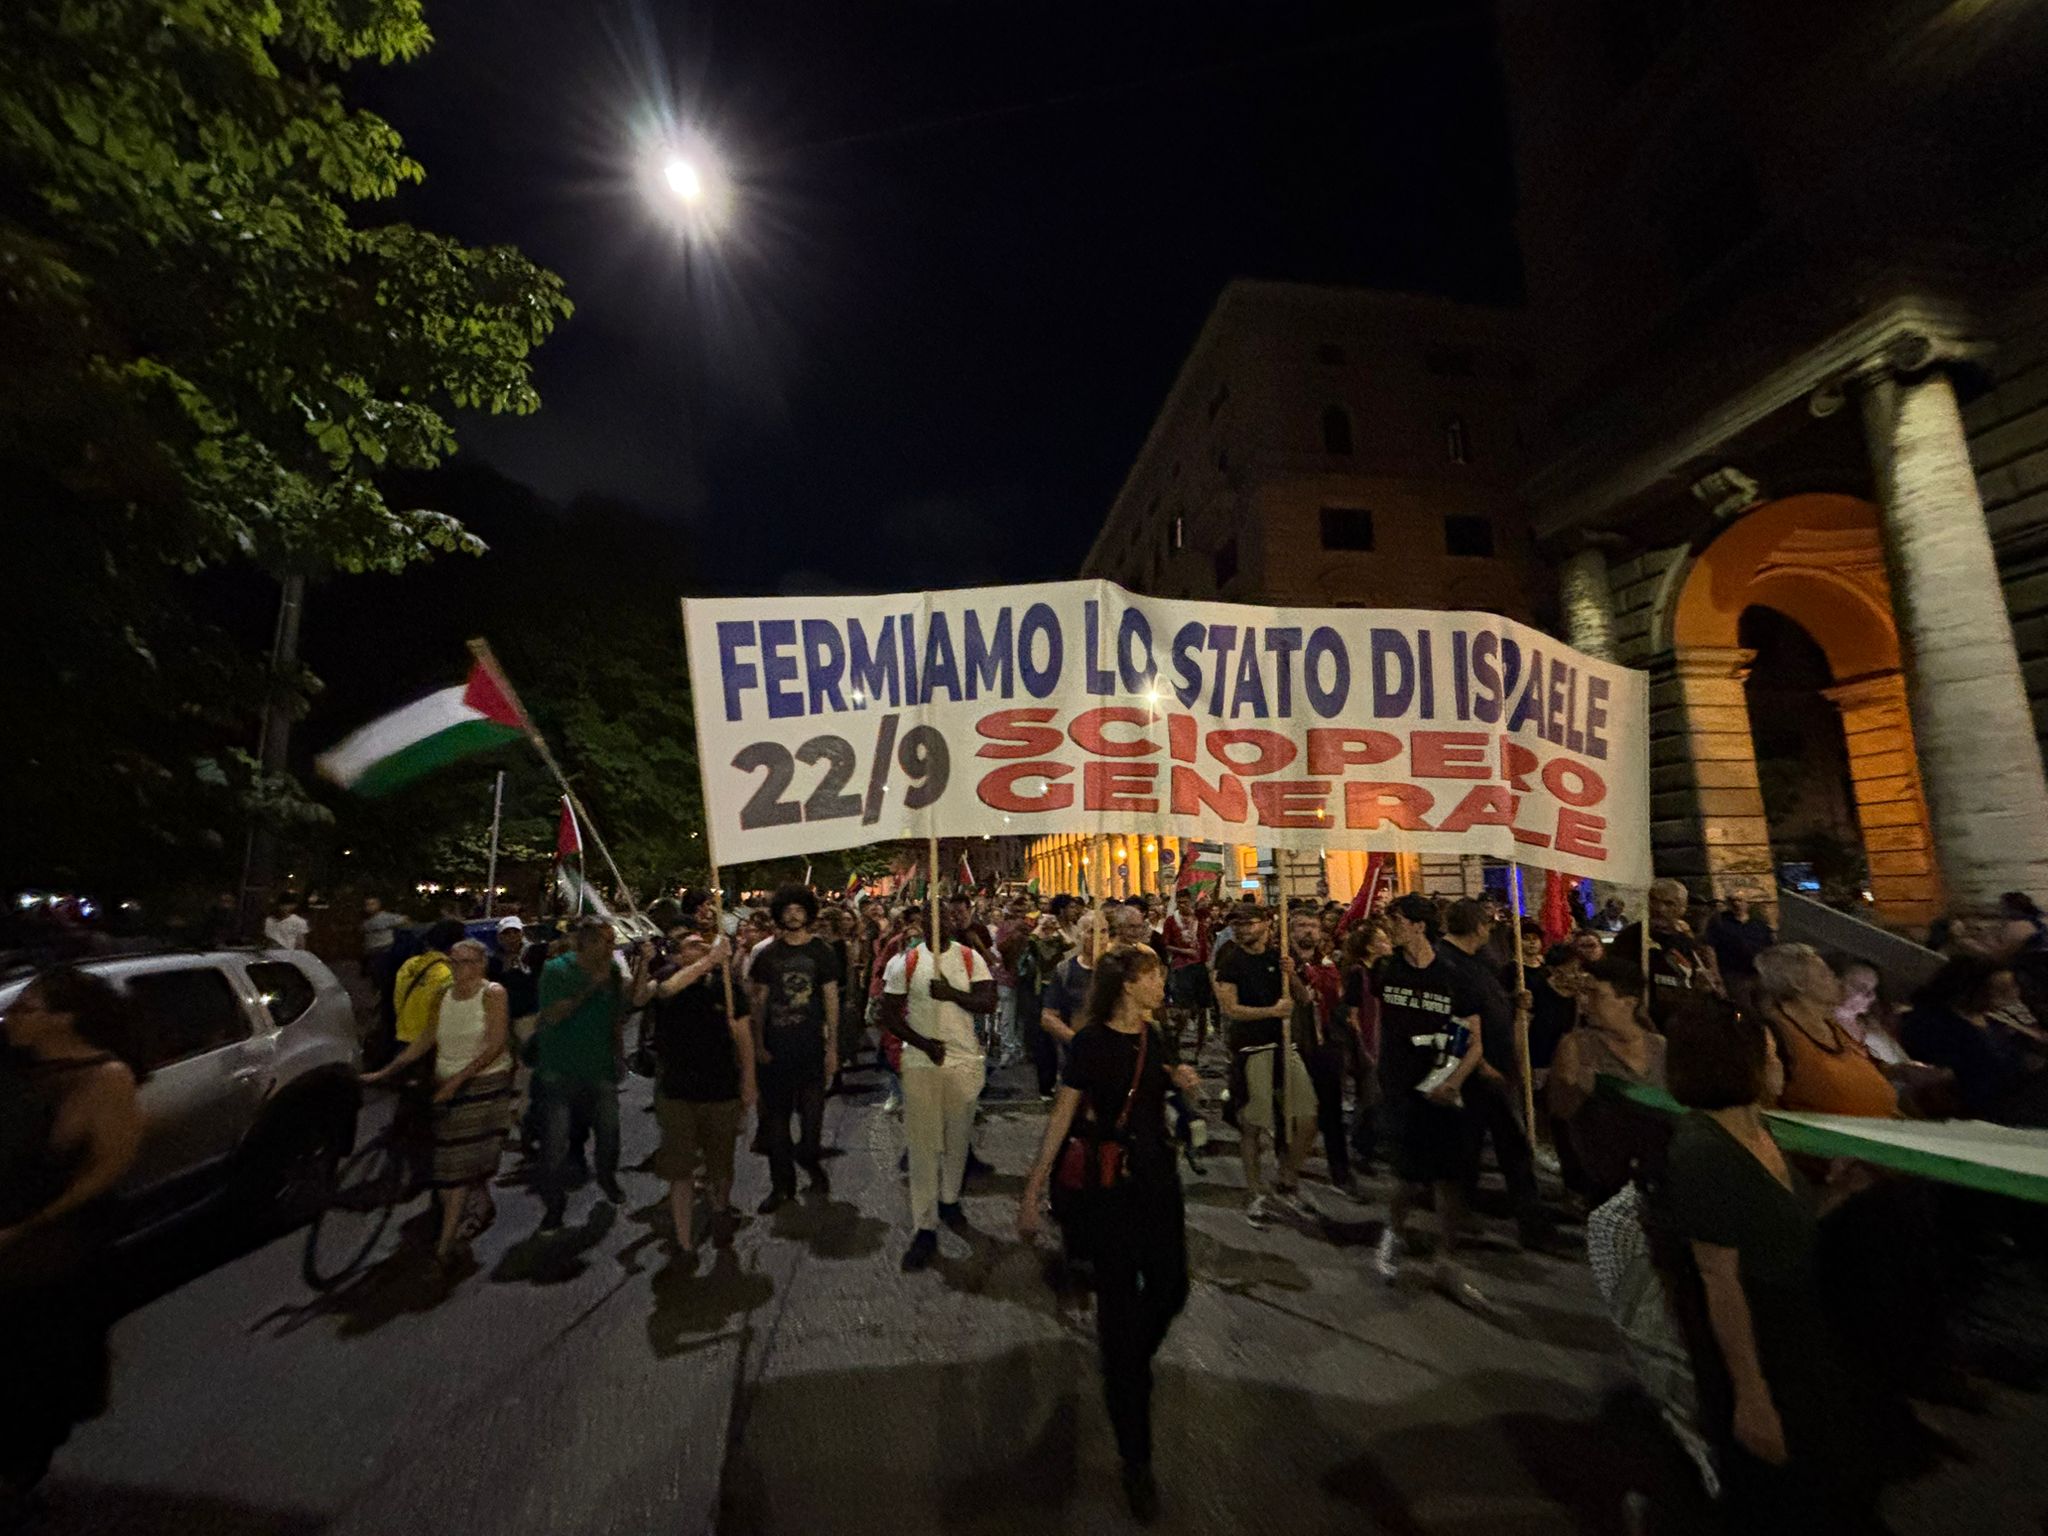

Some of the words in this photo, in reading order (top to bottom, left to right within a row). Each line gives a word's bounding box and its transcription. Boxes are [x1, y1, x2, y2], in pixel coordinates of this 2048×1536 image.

[717, 602, 1063, 721] FERMIAMO
[1085, 600, 1158, 696] LO
[1171, 621, 1351, 719] STATO
[1370, 628, 1434, 719] DI
[731, 713, 951, 830] 22/9
[975, 706, 1607, 807] SCIOPERO
[976, 761, 1607, 861] GENERALE
